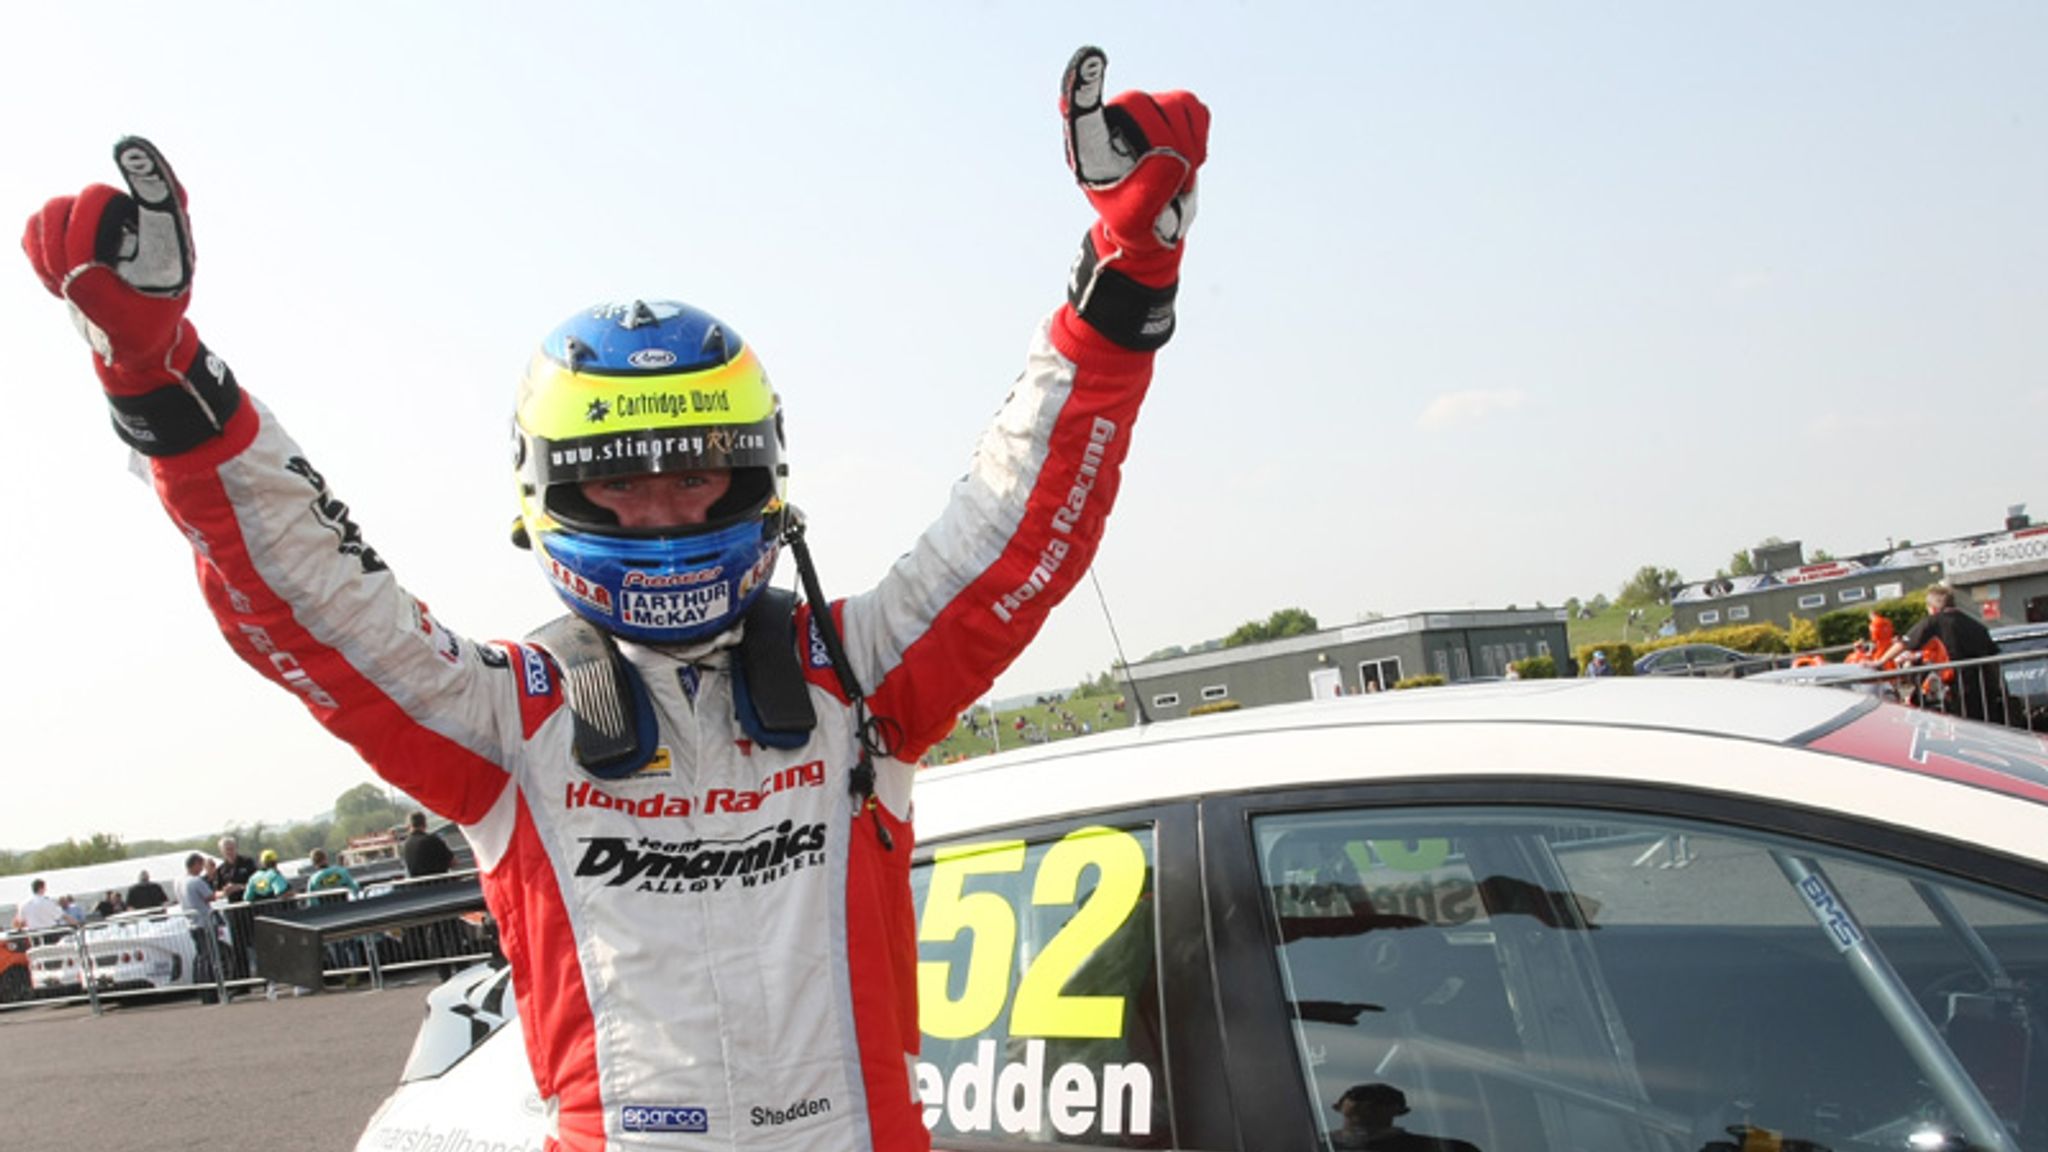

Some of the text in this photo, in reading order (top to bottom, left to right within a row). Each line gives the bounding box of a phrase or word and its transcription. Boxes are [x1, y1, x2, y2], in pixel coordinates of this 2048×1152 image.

[616, 389, 730, 418] Cartridge World
[991, 416, 1117, 623] Honda Racing
[624, 567, 724, 587] Pioneer
[633, 583, 727, 611] ARTHUR
[633, 605, 709, 626] McKAY
[565, 781, 690, 818] Honda
[703, 760, 826, 814] Racing
[575, 819, 827, 887] Dynamics
[637, 837, 701, 854] team
[635, 877, 728, 894] ALLOY
[1801, 874, 1864, 946] BMS
[917, 825, 1147, 1040] 52
[624, 1107, 704, 1130] sparco
[750, 1097, 831, 1127] Shedden
